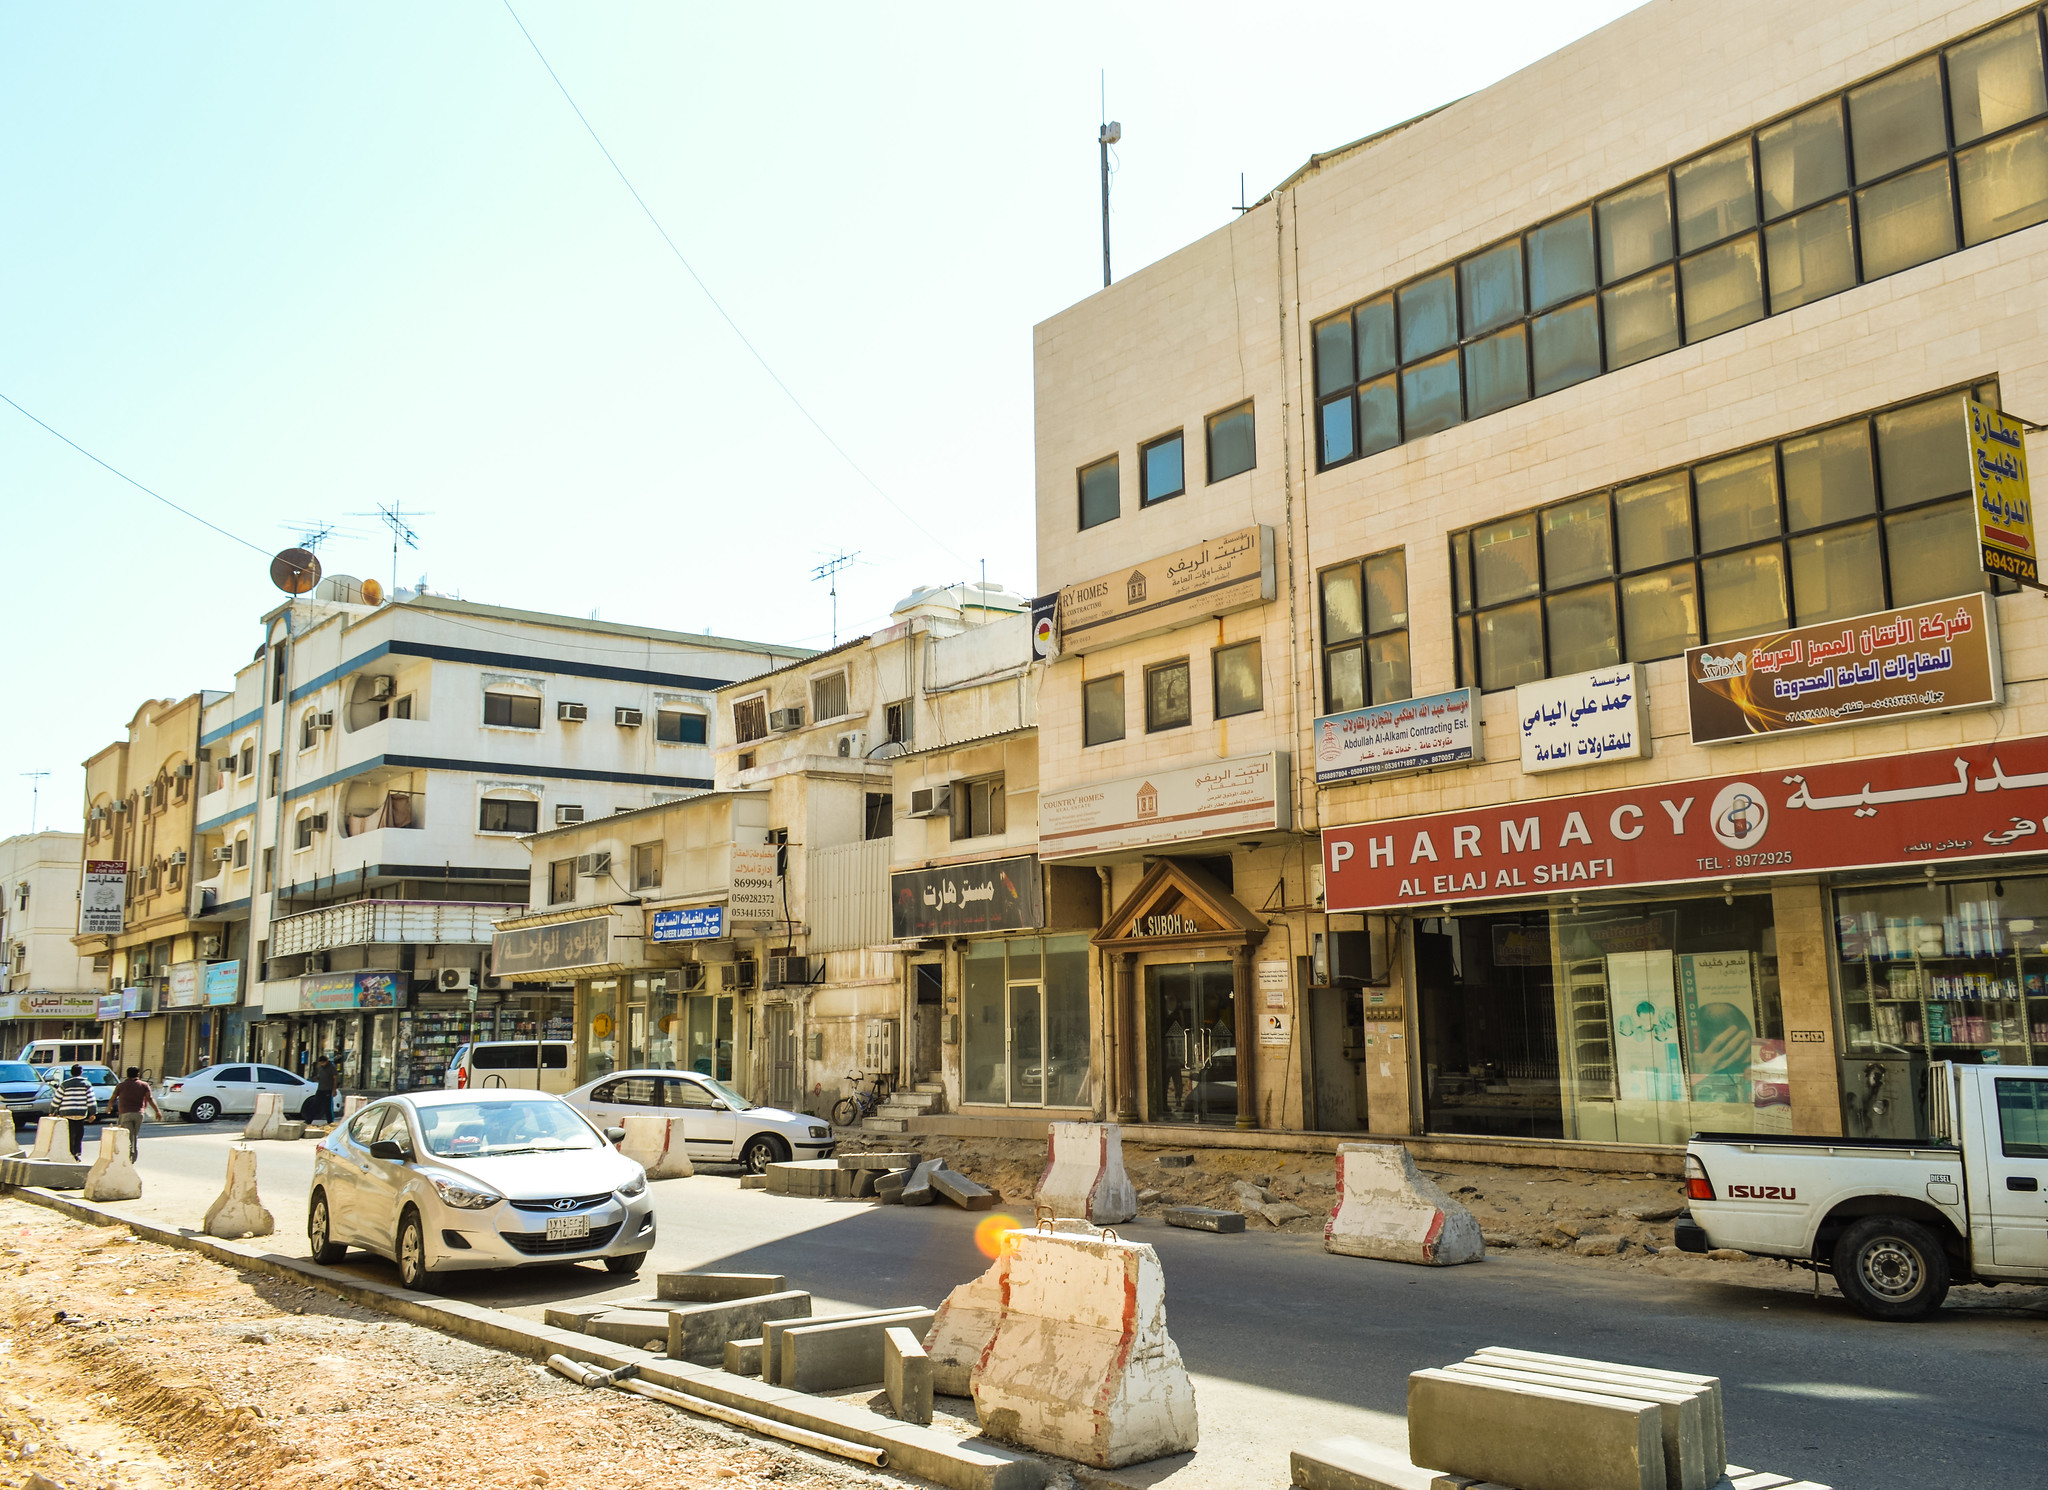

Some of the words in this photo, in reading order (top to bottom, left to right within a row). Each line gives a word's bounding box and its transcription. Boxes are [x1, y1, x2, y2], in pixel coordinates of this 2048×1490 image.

[1971, 405, 2021, 448] عطارة
[1977, 447, 2025, 482] الخليج
[1979, 481, 2031, 526] الدولية
[1214, 534, 1255, 560] البيت
[1194, 561, 1232, 579] للمقاولات
[1985, 549, 2036, 579] 8943724
[1172, 573, 1193, 586] العامة
[1062, 589, 1076, 608] RY
[1077, 582, 1109, 602] HOMES
[1066, 600, 1102, 617] CONTRACTING
[1919, 607, 1973, 643] شركة
[1859, 615, 1915, 656] الأتقان
[1752, 639, 1803, 673] العربية
[1807, 629, 1855, 667] المميز
[1704, 662, 1742, 679] WDA
[1837, 659, 1881, 688] العامة
[1883, 646, 1952, 683] للمقاولات
[1590, 672, 1631, 688] مؤسسة
[1773, 667, 1835, 700] المحدودة
[1418, 702, 1430, 717] الله
[1431, 704, 1445, 718] عبد
[1445, 696, 1469, 714] مؤسسة
[1570, 696, 1598, 728] علي
[1601, 693, 1632, 712] حمد
[1342, 715, 1370, 734] والمقاولات
[1370, 710, 1393, 729] للتجارة
[1523, 700, 1567, 737] اليامي
[1343, 735, 1374, 750] Abdullah
[1375, 729, 1409, 744] Al-Alkami
[1409, 722, 1453, 738] Contracting
[1454, 718, 1469, 730] Est.
[1432, 736, 1453, 748] مقاولات
[1382, 747, 1394, 756] عامة
[1395, 743, 1411, 754] خدمات
[1419, 741, 1431, 749] عامة
[1534, 741, 1571, 761] العامة
[1577, 731, 1632, 759] للمقاولات
[1360, 750, 1375, 762] عقار
[1431, 753, 1455, 763] 8670057
[1235, 762, 1269, 778] البيت
[1781, 755, 2048, 819] دلية
[1043, 796, 1077, 810] COUNTRY
[1078, 792, 1105, 804] HOMES
[1330, 795, 1697, 873] PHARMACY
[1696, 856, 1723, 871] TEL
[1735, 850, 1793, 868] 8972925
[733, 877, 773, 889] 8699994
[1398, 878, 1427, 897] AL
[1433, 870, 1487, 894] ELAJ
[1495, 867, 1527, 889] AL
[1533, 857, 1614, 884] SHAFI
[731, 893, 775, 904] 0569282372
[922, 878, 957, 912] هارت
[958, 879, 995, 910] مستر
[703, 912, 720, 927] عبير
[731, 908, 774, 918] 0534415551
[677, 927, 693, 938] LADIES
[692, 926, 709, 937] TAILOR
[1147, 914, 1181, 936] SUBOH
[1184, 919, 1198, 933] CO.
[1698, 957, 1723, 969] كثيف
[1724, 956, 1746, 968] شعر
[31, 996, 63, 1008] أصايل
[1930, 1174, 1950, 1183] DIESEL
[1728, 1184, 1797, 1200] ISUZU
[549, 1229, 568, 1239] 1714
